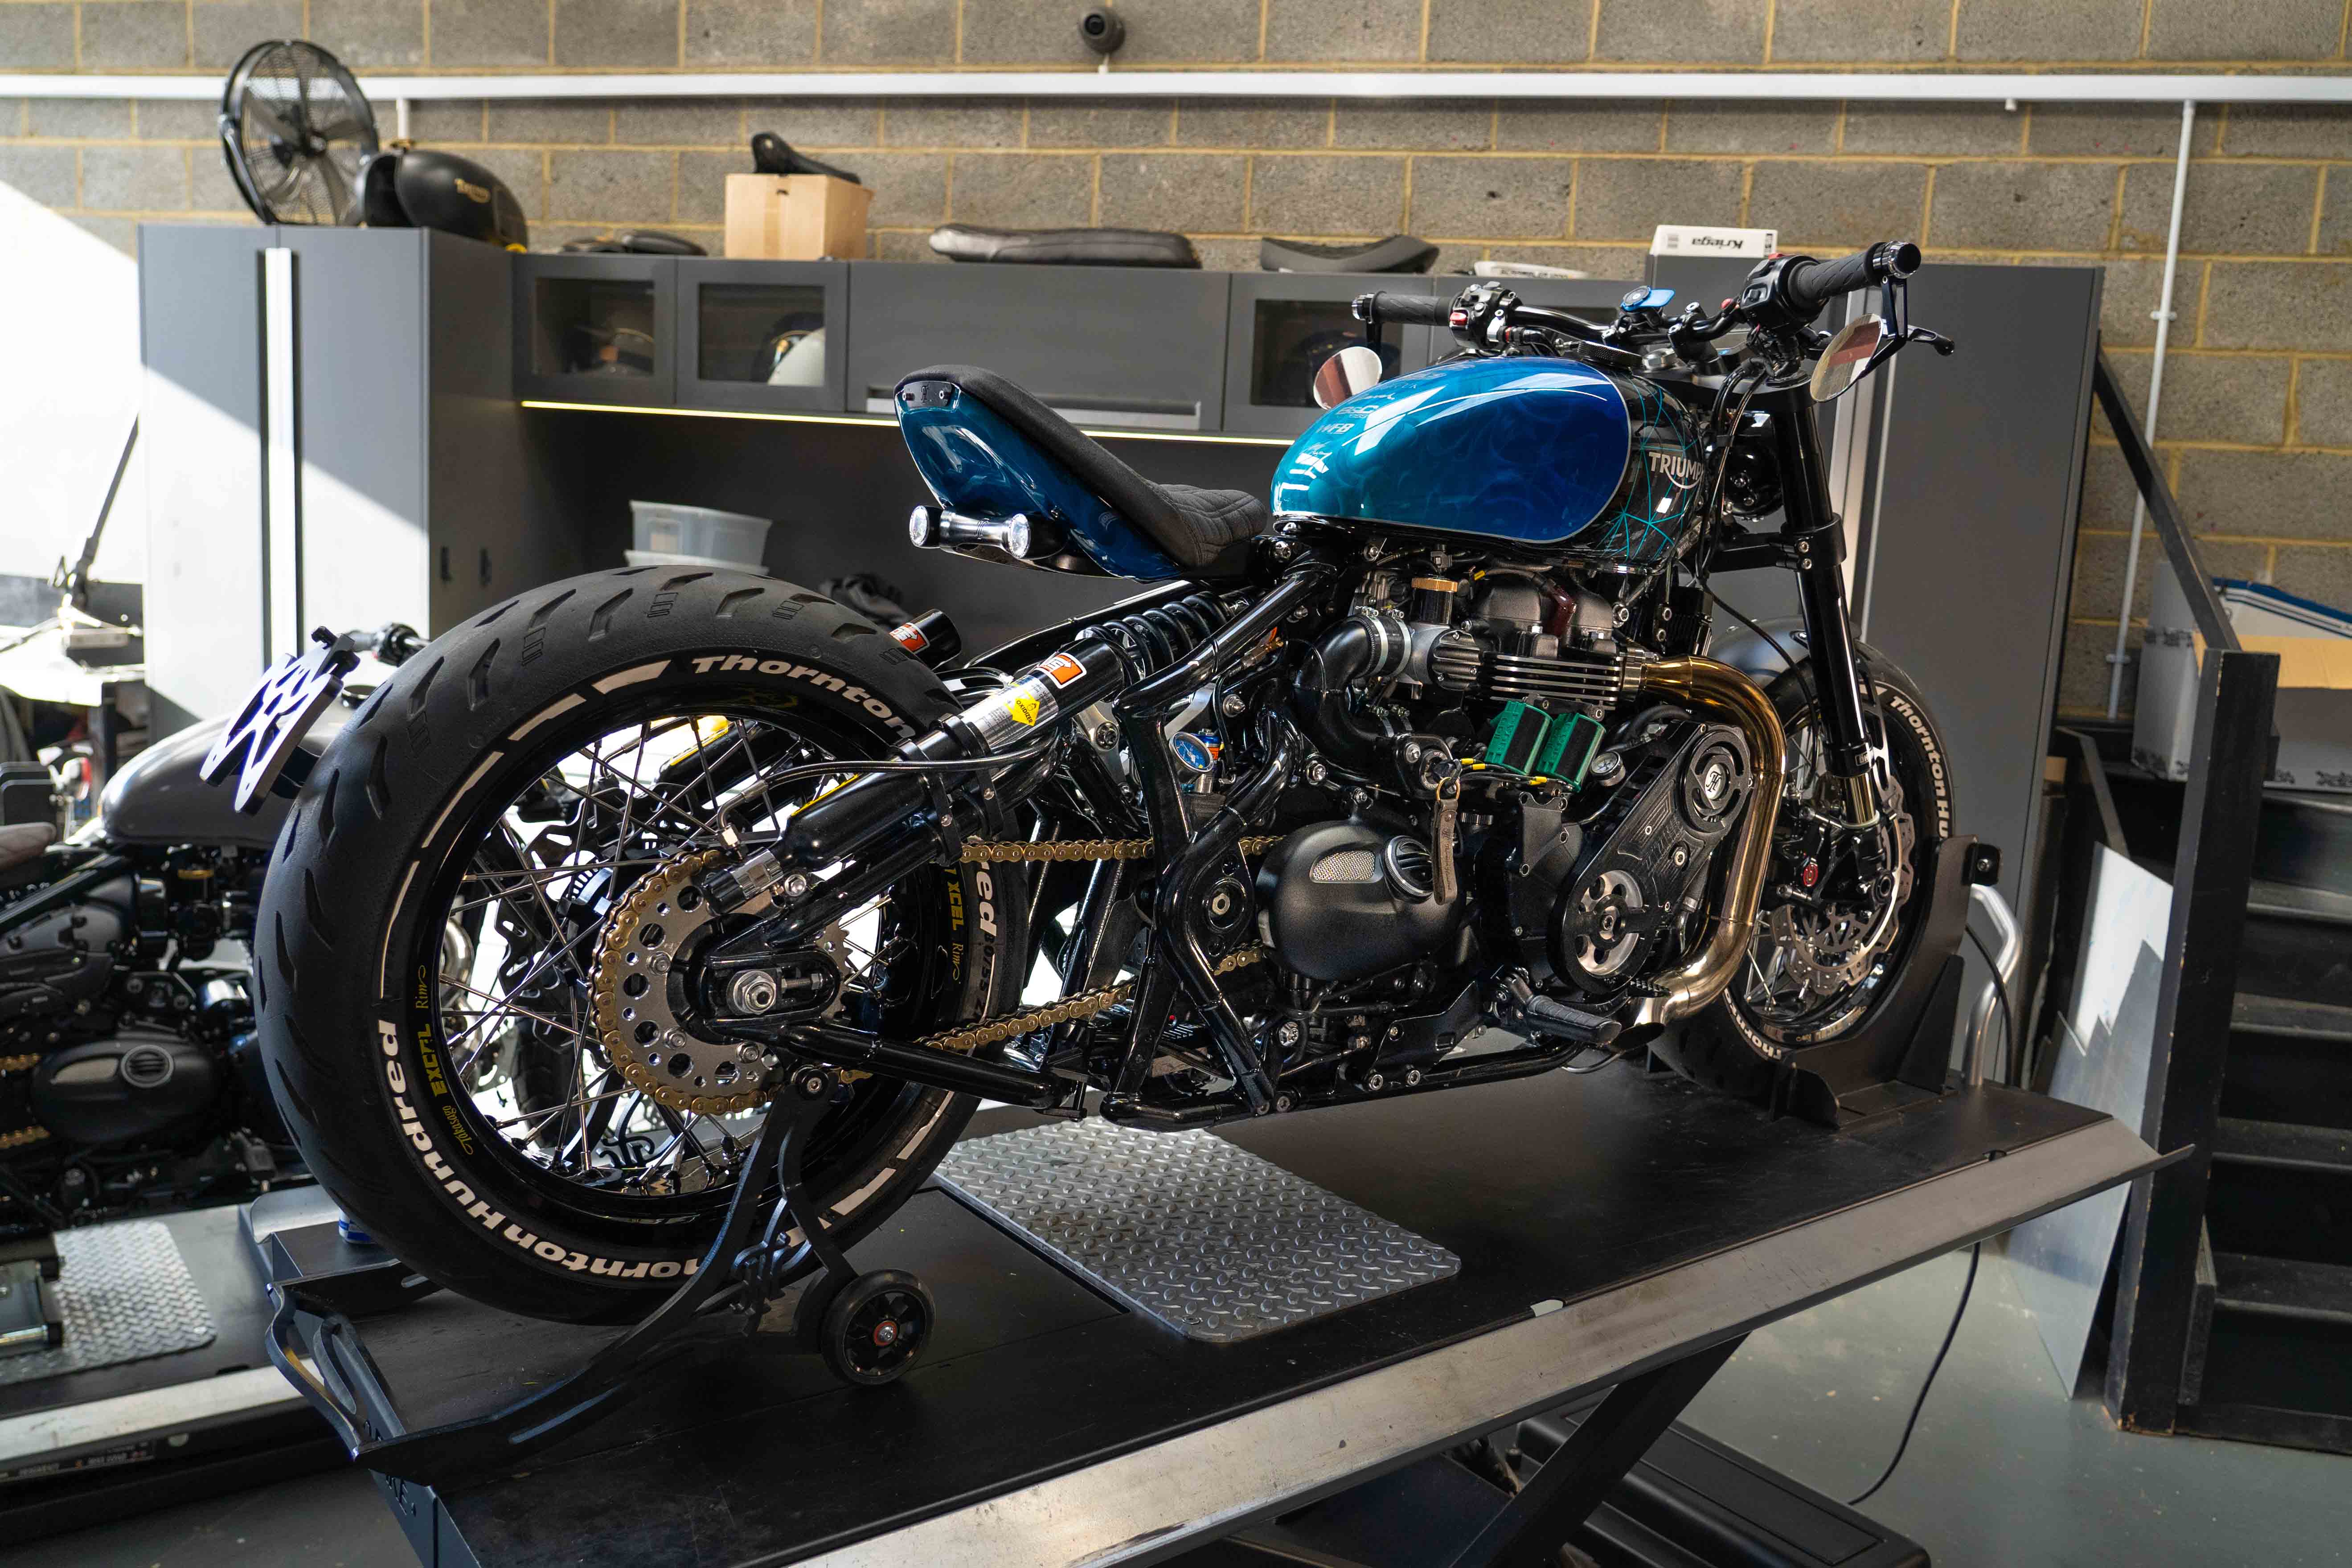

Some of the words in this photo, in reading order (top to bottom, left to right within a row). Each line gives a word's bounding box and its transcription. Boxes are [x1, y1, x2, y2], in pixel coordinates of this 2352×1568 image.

[1692, 237, 1743, 250] Kriega
[692, 654, 918, 741] Thornton
[1016, 700, 1033, 724] OXIDIZER
[1890, 696, 1947, 796] Thornton
[377, 1019, 507, 1230] Hundred
[443, 1105, 474, 1156] Takasago
